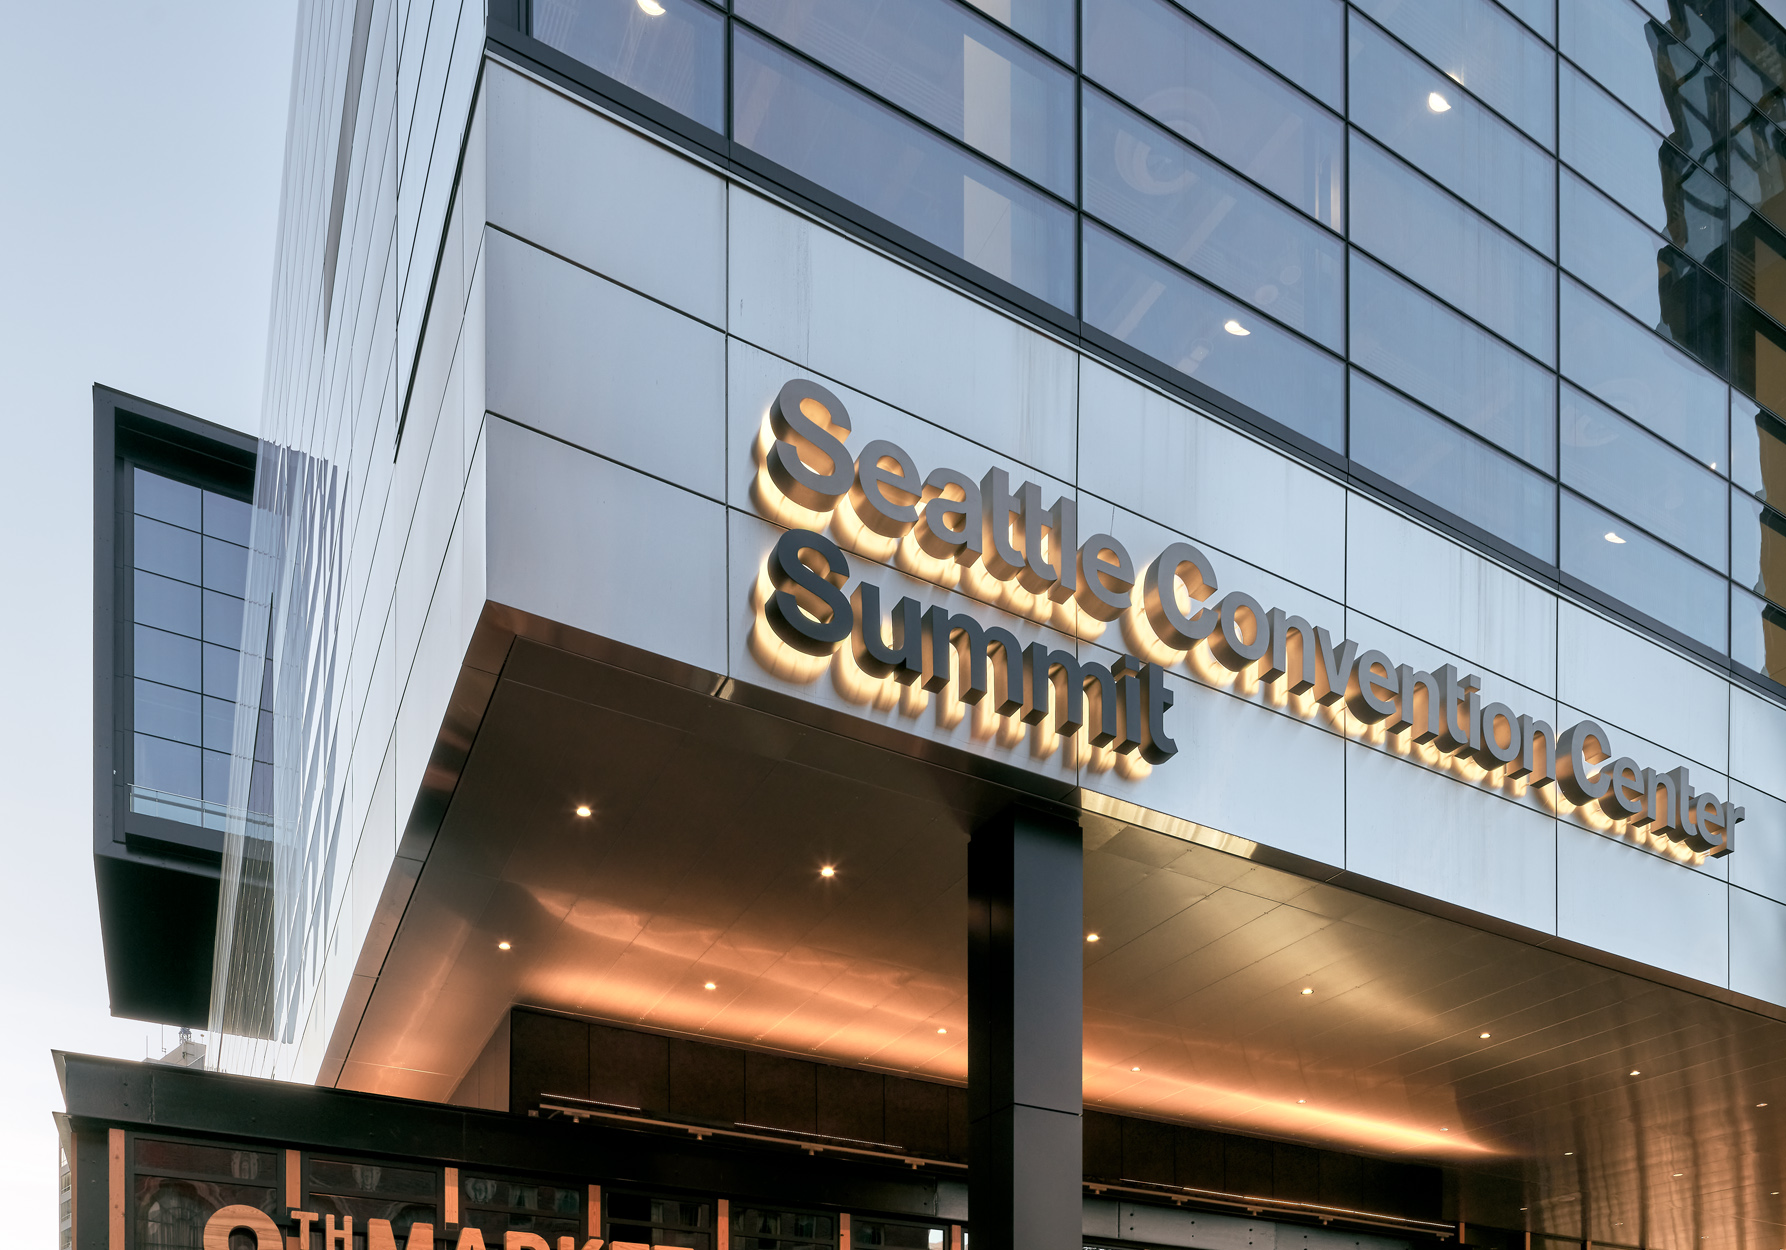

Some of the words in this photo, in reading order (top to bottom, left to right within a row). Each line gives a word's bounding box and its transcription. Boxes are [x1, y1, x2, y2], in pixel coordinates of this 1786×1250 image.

[765, 529, 1179, 765] Summit
[766, 378, 1135, 622] Seattle
[1143, 542, 1556, 788] Convention
[1556, 719, 1746, 859] Center
